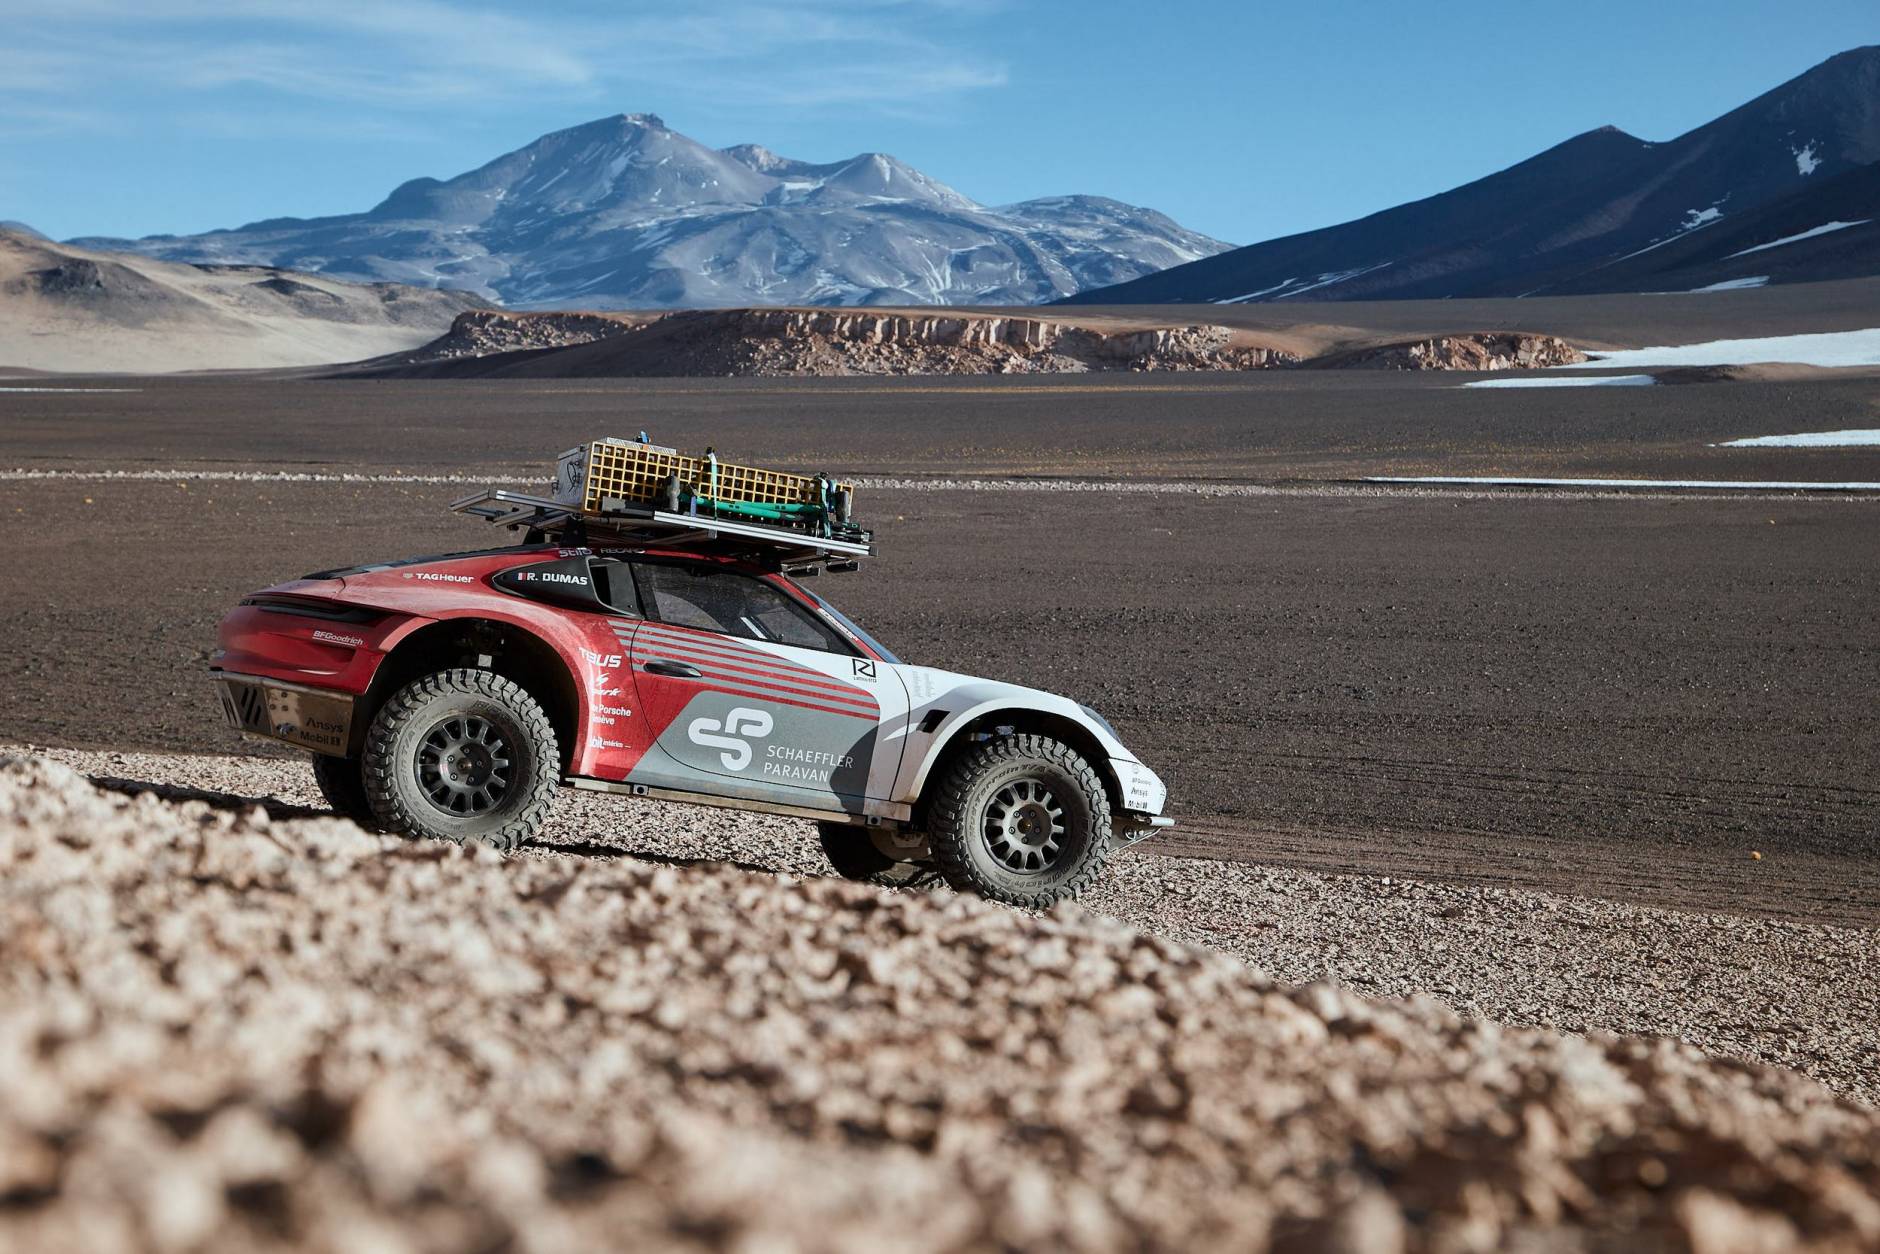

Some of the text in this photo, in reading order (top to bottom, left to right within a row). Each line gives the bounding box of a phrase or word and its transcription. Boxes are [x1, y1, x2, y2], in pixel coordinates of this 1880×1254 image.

[527, 572, 589, 586] R. DUMAS
[313, 630, 364, 646] BFGoodrich
[599, 703, 632, 717] Porsche
[306, 717, 344, 733] Ansys
[766, 745, 854, 769] SCHAEFFLER
[763, 762, 830, 782] PARAVAN
